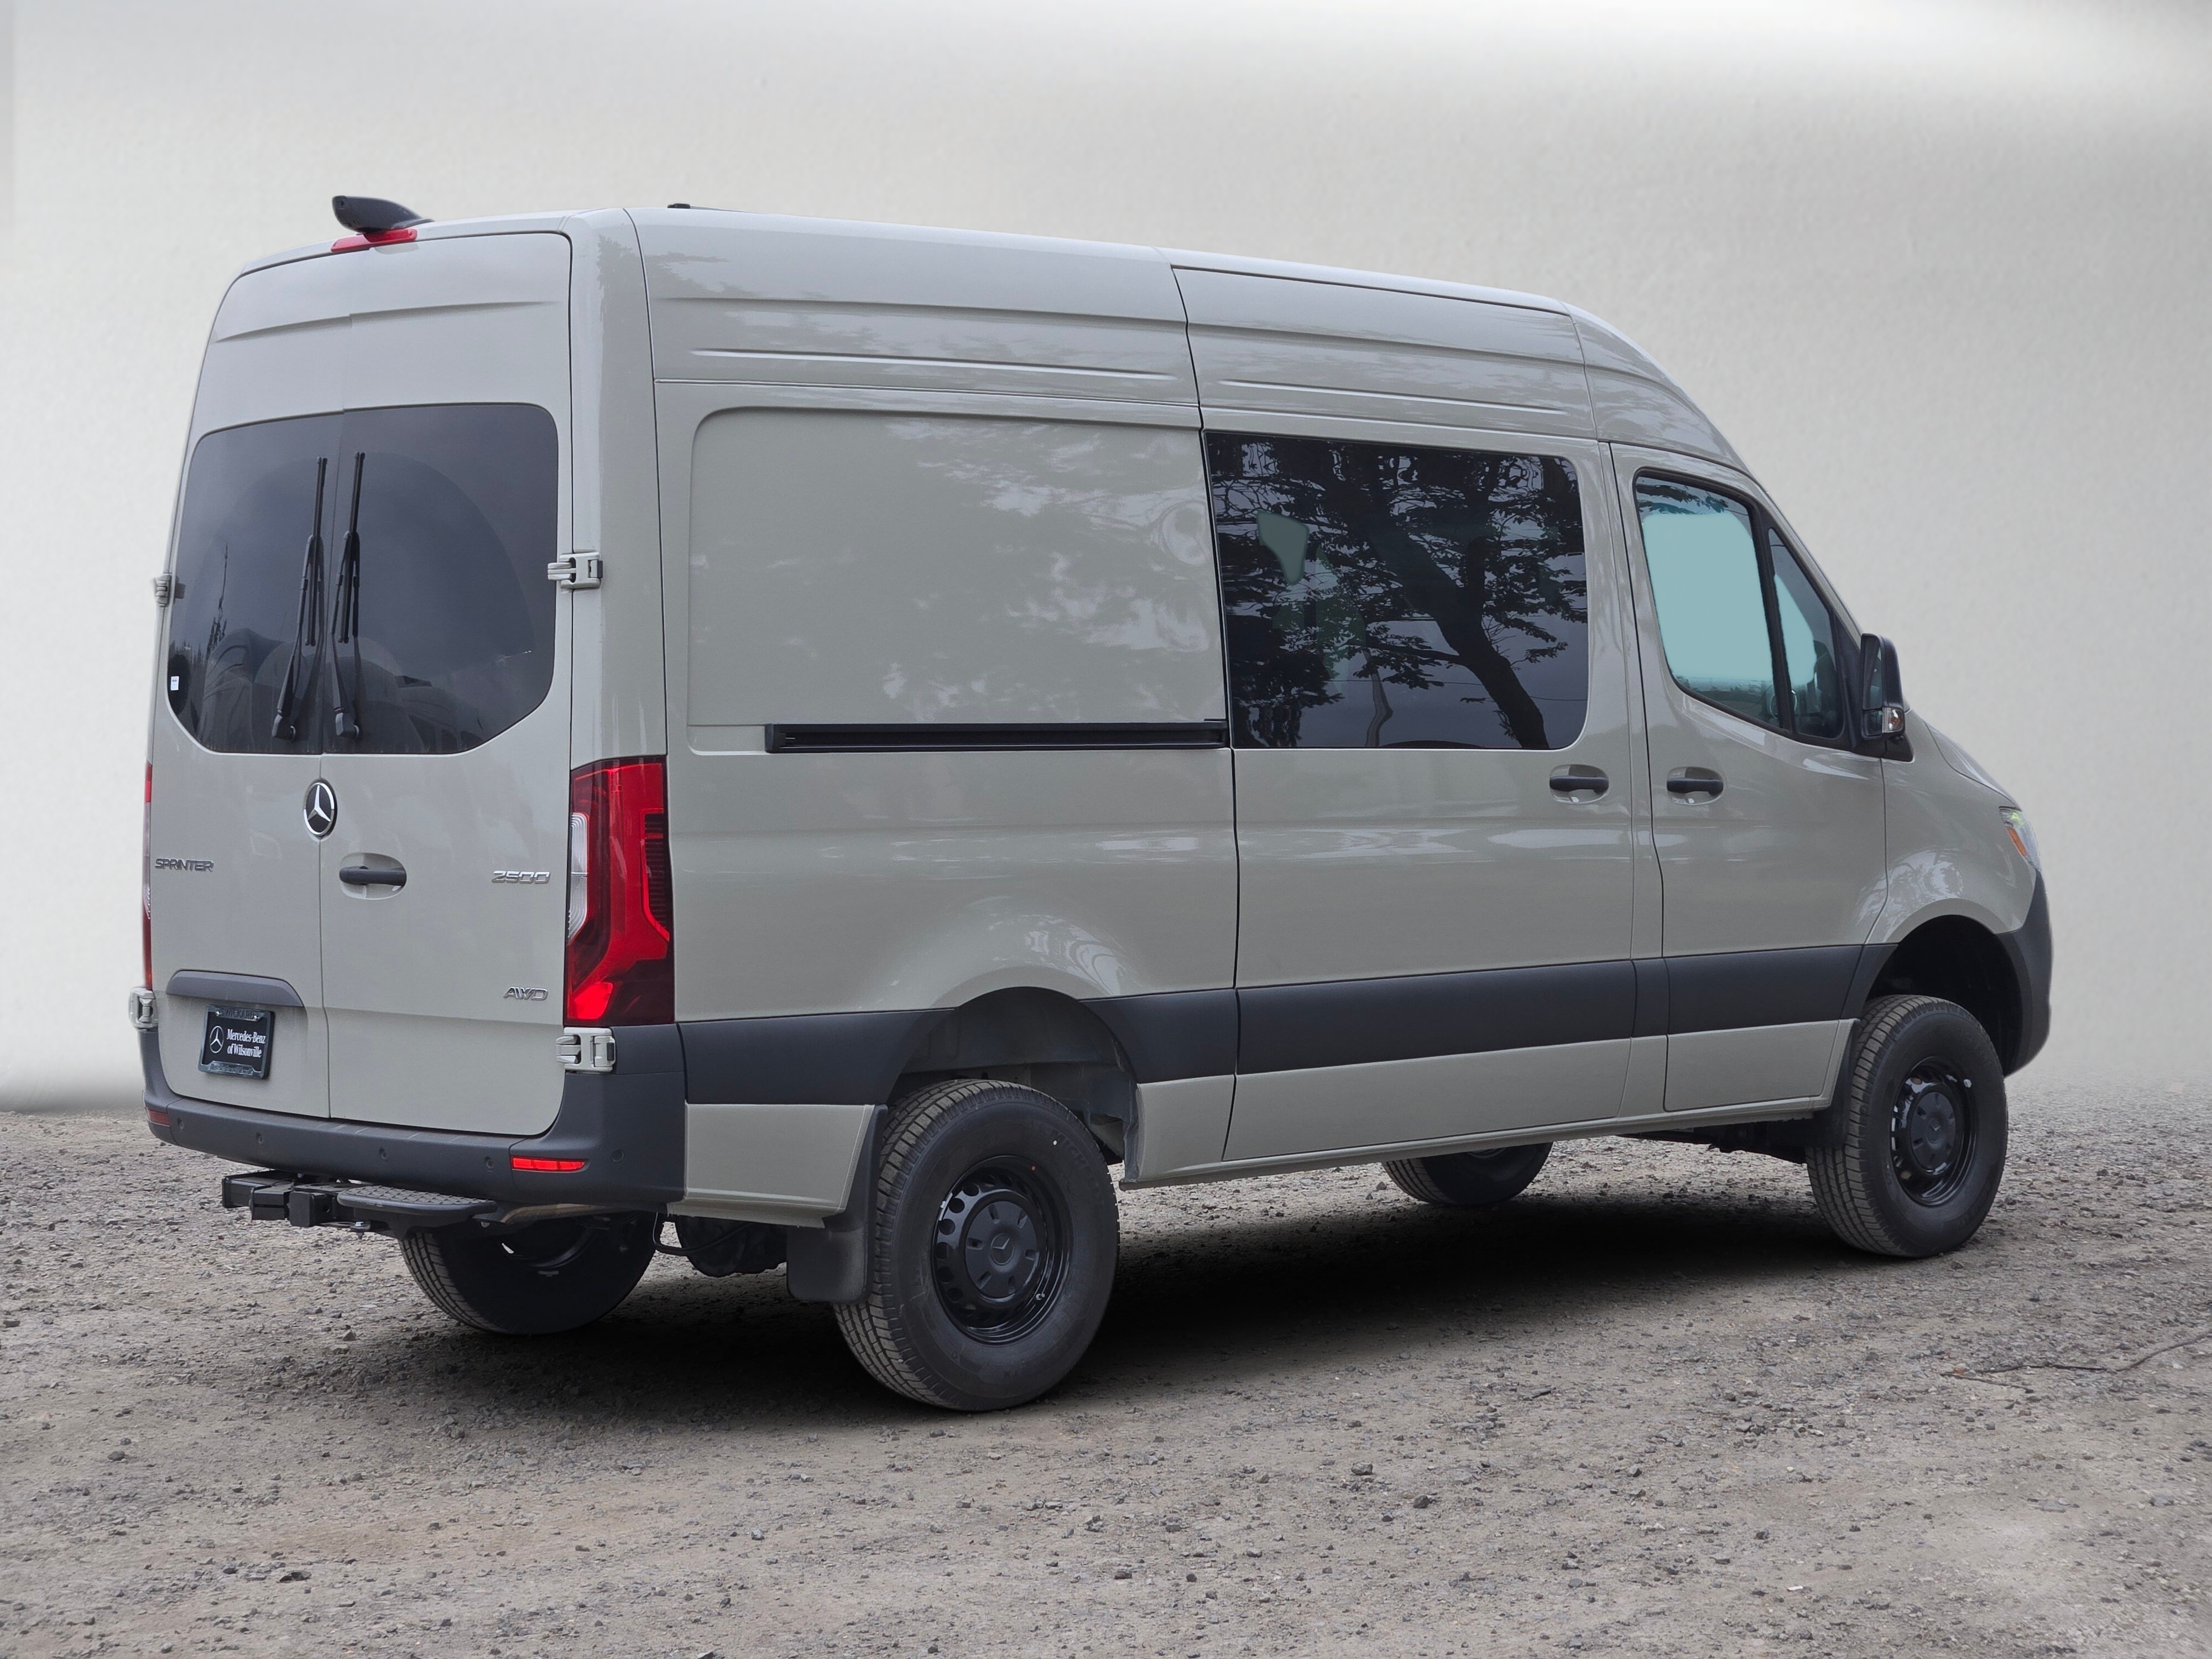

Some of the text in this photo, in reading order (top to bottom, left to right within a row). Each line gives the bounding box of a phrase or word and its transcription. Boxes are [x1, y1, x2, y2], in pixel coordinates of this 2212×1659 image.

[155, 858, 214, 872] SPRINTER
[492, 870, 550, 884] 2500
[503, 986, 549, 1001] AWD
[227, 1029, 265, 1044] Mercedes-Benz
[227, 1044, 262, 1057] of Wilsonville
